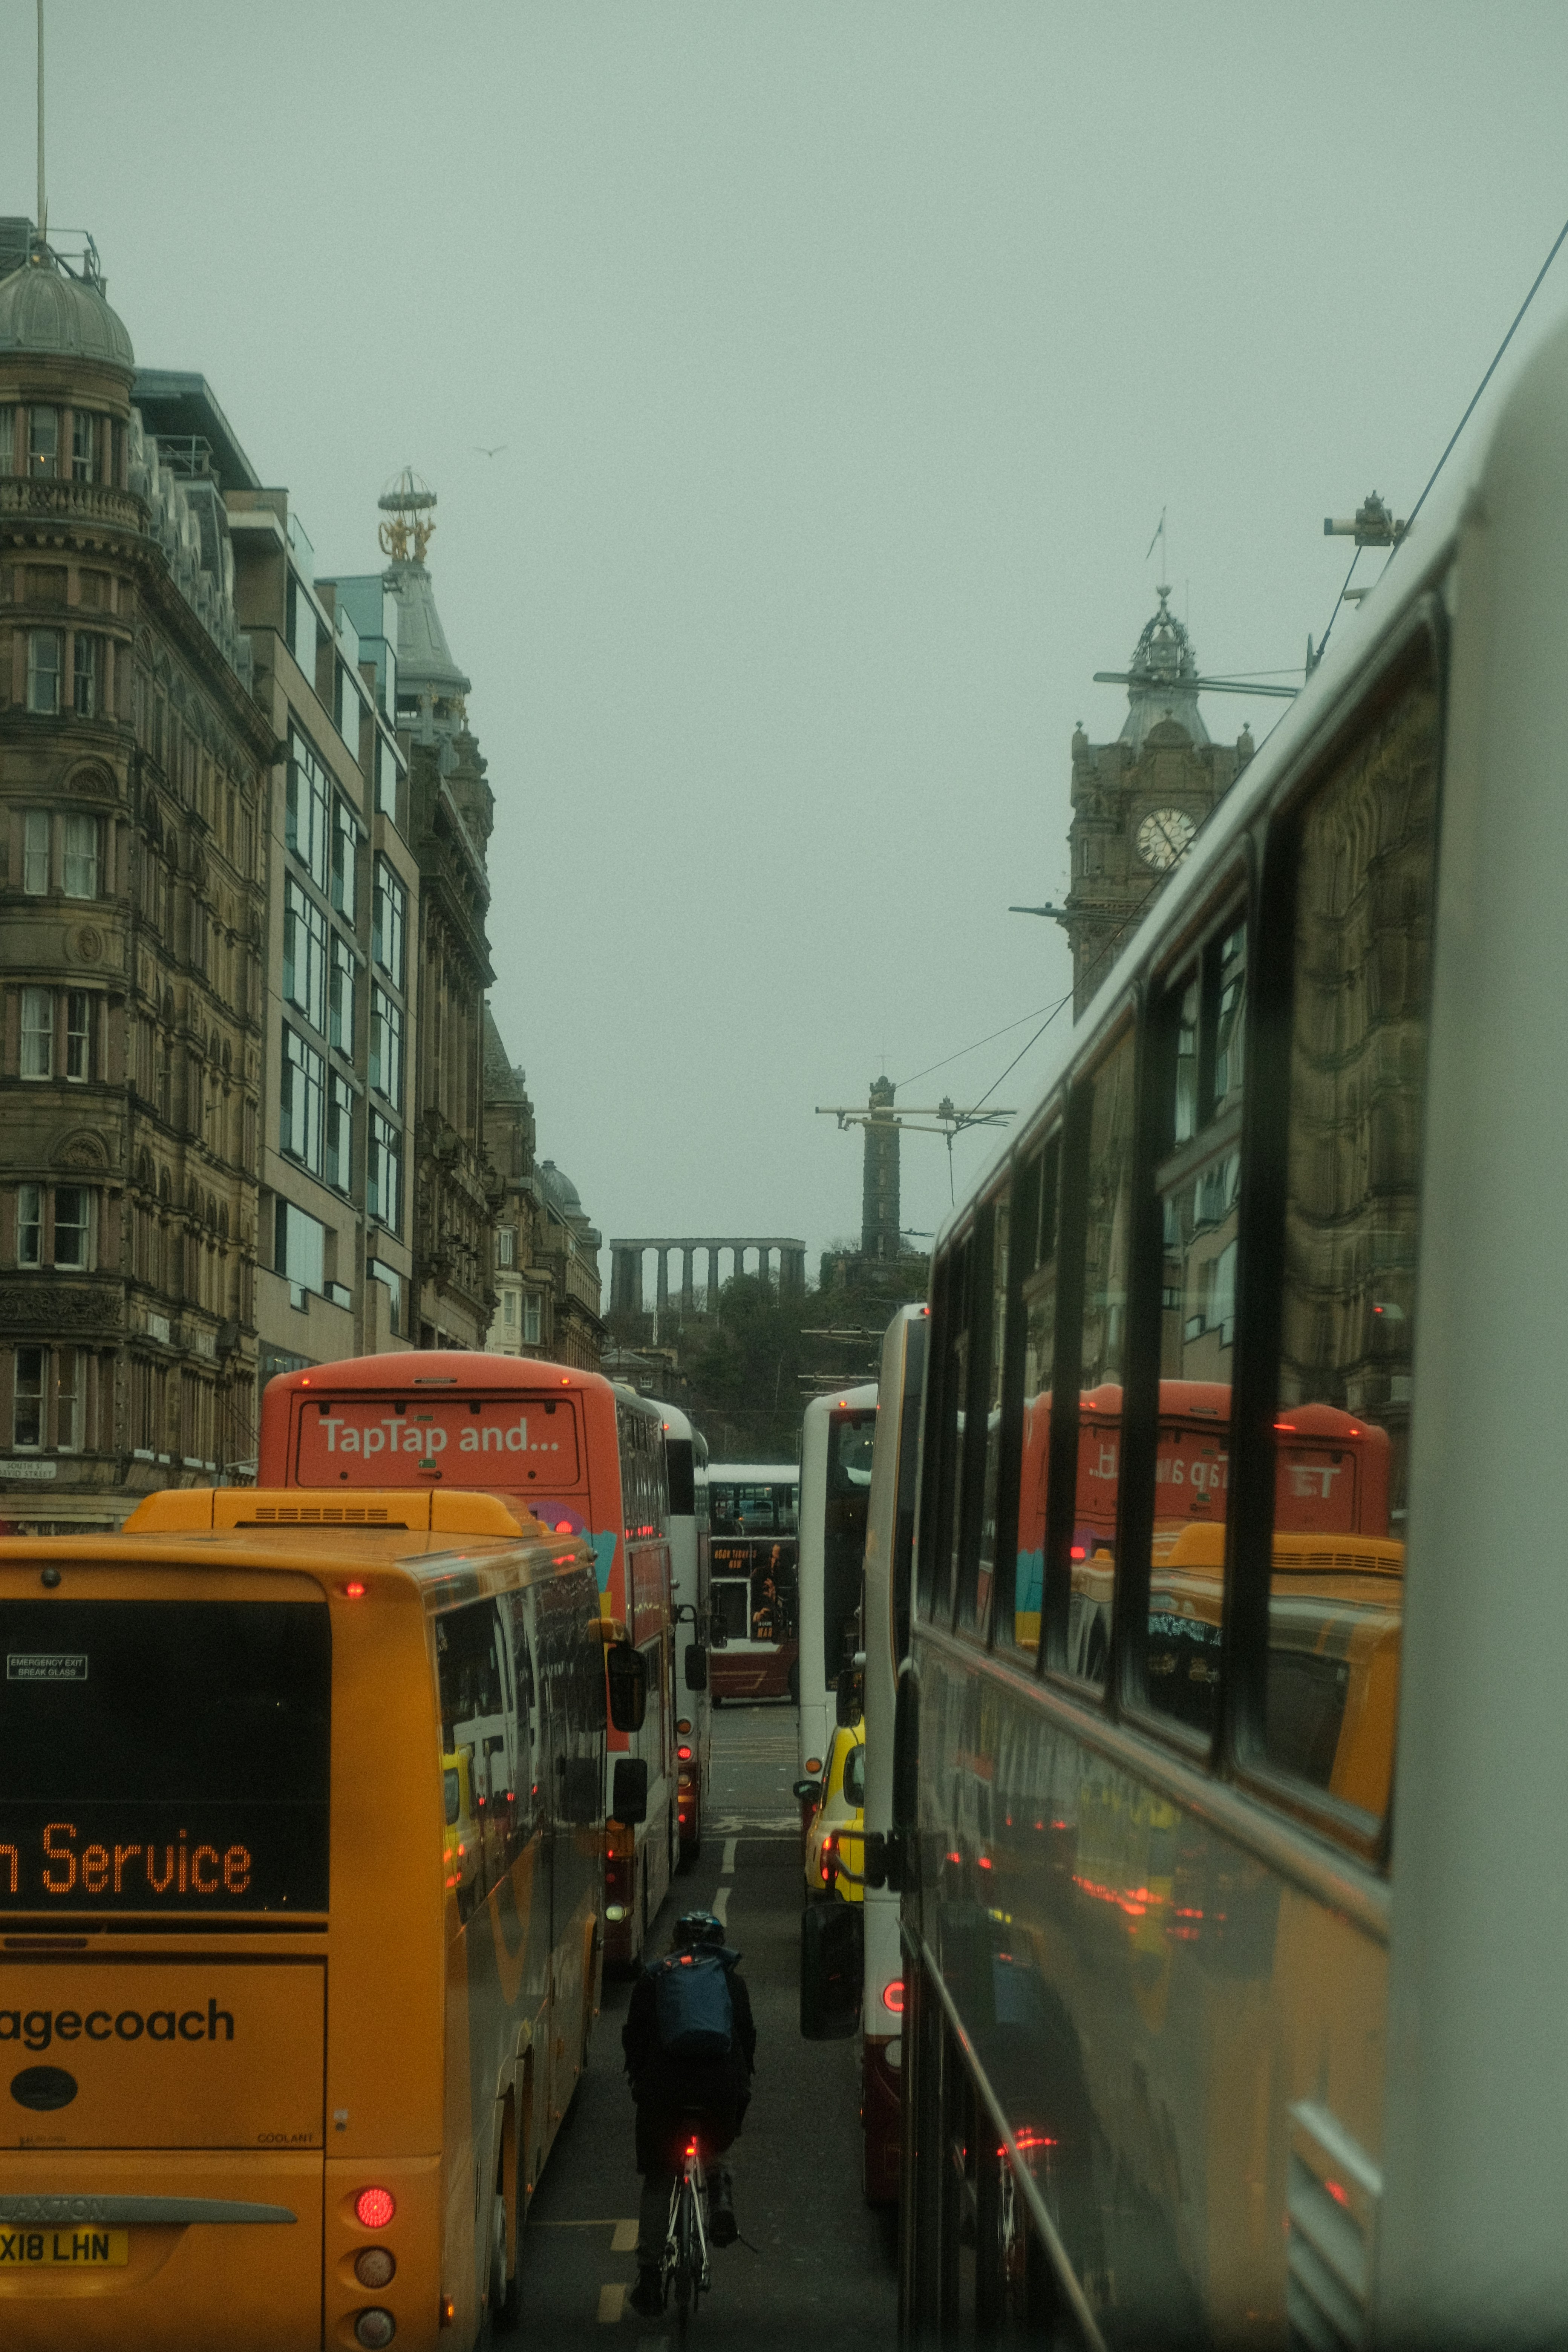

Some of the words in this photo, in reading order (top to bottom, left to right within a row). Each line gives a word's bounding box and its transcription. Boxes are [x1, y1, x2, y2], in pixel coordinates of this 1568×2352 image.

[318, 1418, 447, 1459] TapTap
[459, 1418, 559, 1451] and...
[43, 1823, 251, 1893] Service
[257, 2133, 313, 2143] COOLANT
[53, 2234, 109, 2261] LHN
